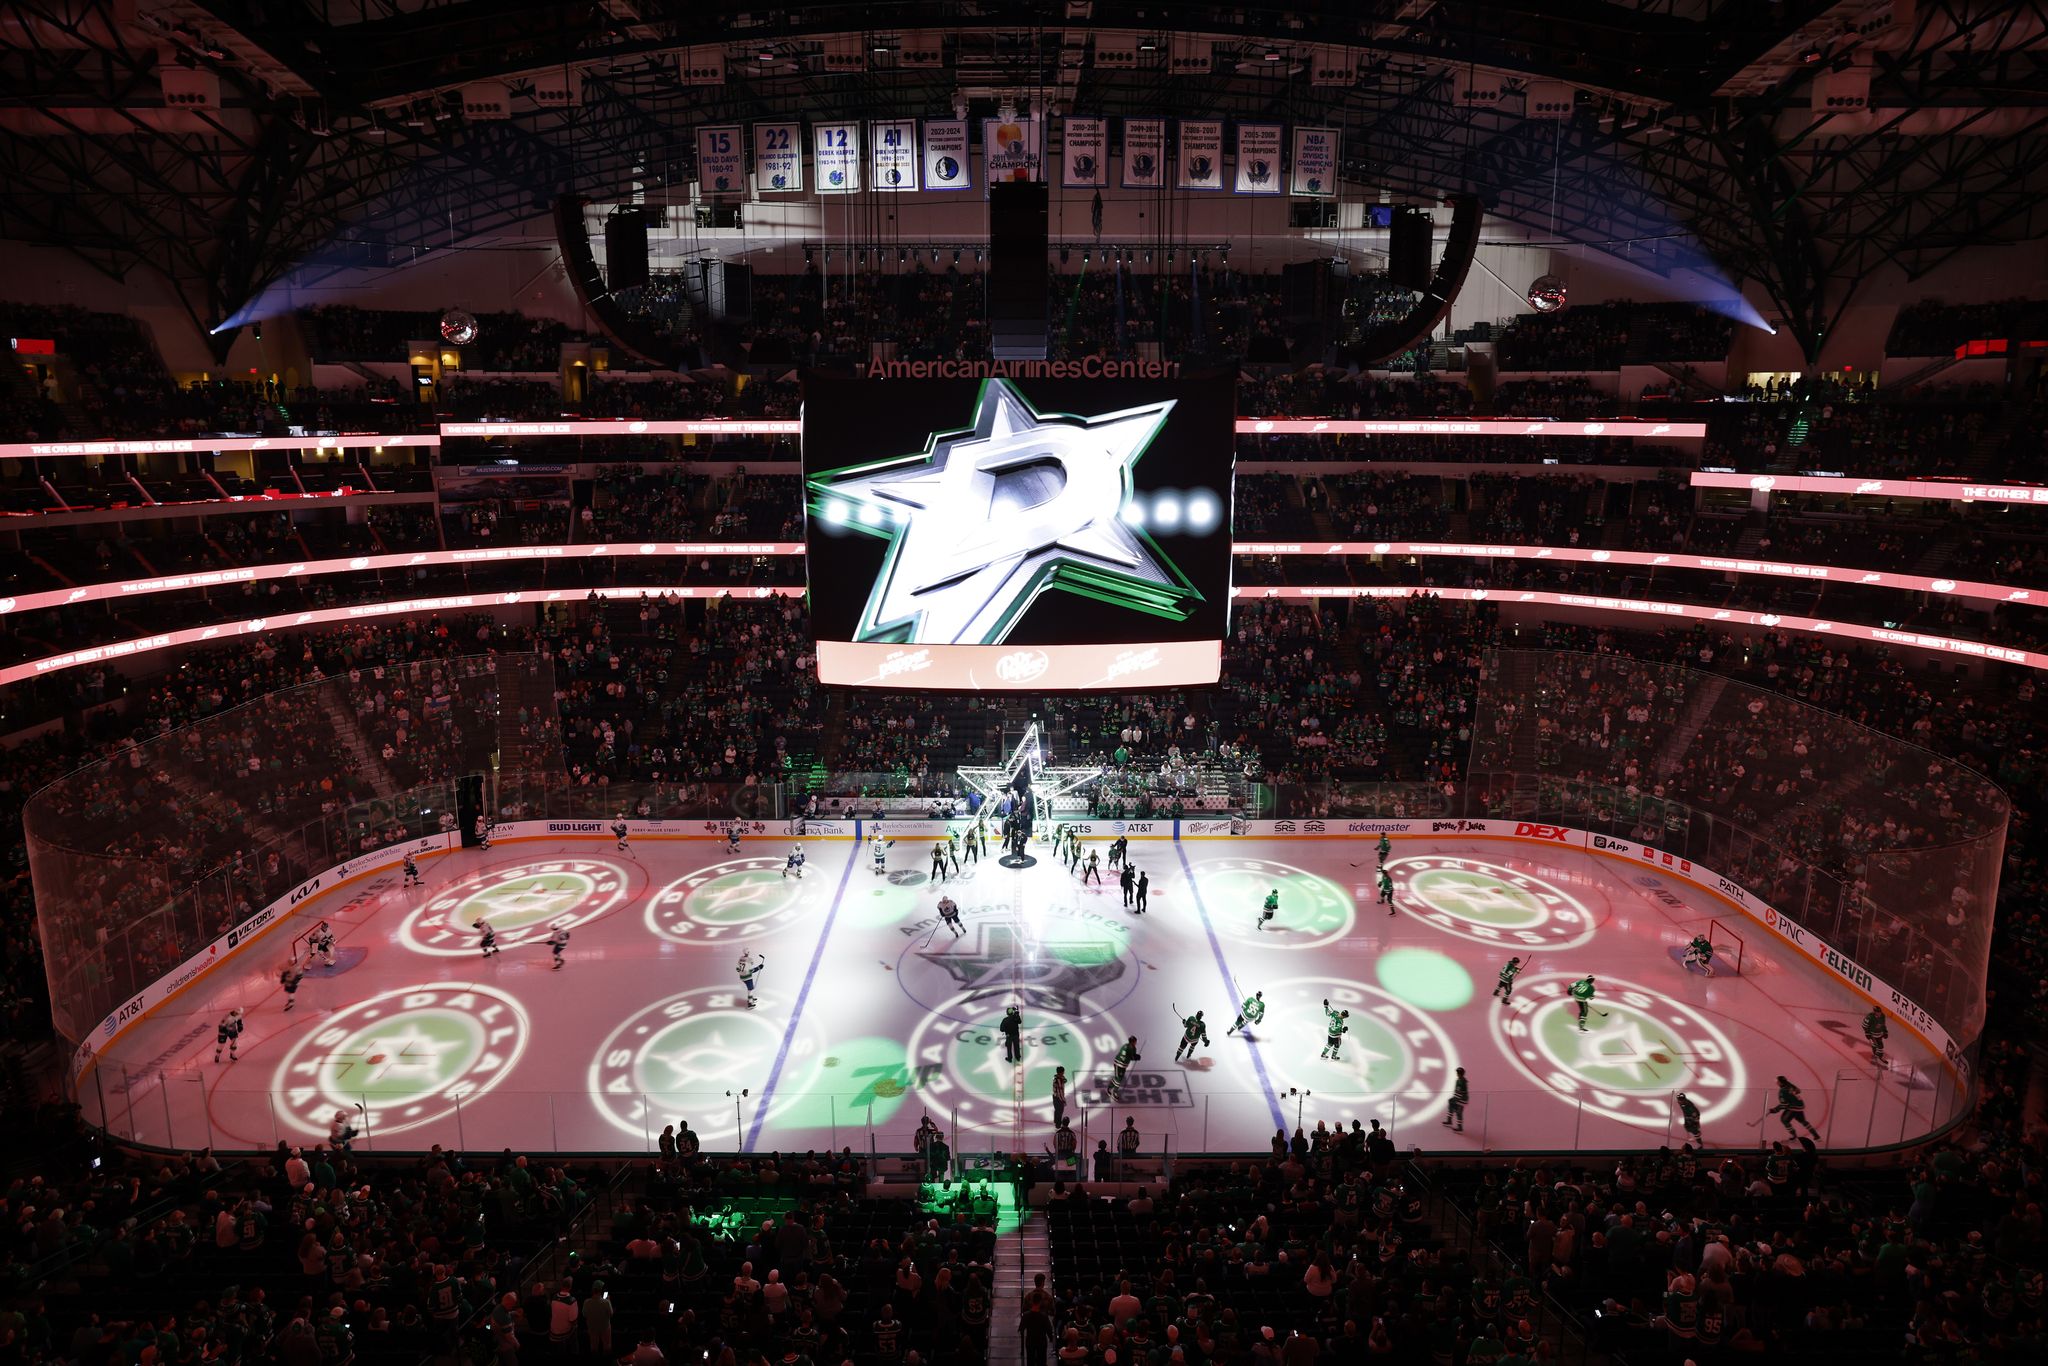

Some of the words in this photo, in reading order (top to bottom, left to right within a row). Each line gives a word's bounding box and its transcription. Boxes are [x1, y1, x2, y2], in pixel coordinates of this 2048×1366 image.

[826, 130, 848, 147] 12
[884, 129, 902, 146] 41
[930, 128, 961, 136] 2023-2024
[709, 133, 730, 154] 15
[766, 129, 789, 150] 22
[1306, 135, 1325, 144] NBA
[930, 144, 962, 152] CHAMPIONS
[720, 155, 738, 164] DAVIS
[992, 154, 1006, 162] 2011
[709, 165, 733, 174] 1980-92
[765, 162, 791, 170] 1981-92
[511, 425, 538, 433] THING
[52, 444, 82, 453] OTHER
[84, 443, 115, 453] BEST
[117, 442, 153, 453] THING
[155, 441, 172, 452] ON
[174, 441, 192, 451] ICE
[1962, 487, 1986, 496] THE
[1988, 489, 2030, 499] OTHER
[1738, 562, 1761, 571] BEST
[1763, 564, 1792, 573] THING
[1793, 567, 1809, 575] ON
[138, 581, 164, 590] OTHER
[165, 577, 190, 587] BEST
[192, 574, 221, 584] THING
[223, 570, 237, 580] ON
[239, 570, 254, 578] ICE
[388, 602, 411, 610] BEST
[413, 600, 440, 608] THING
[442, 598, 456, 606] ON
[1596, 599, 1620, 607] BEST
[1621, 600, 1649, 610] THING
[1651, 603, 1666, 612] ON
[1667, 605, 1683, 613] ICE
[1872, 630, 1888, 638] THE
[1889, 633, 1916, 642] OTHER
[1918, 637, 1947, 647] BEST
[1949, 641, 1985, 654] THING
[1986, 647, 2004, 657] ON
[2006, 651, 2025, 661] ICE
[36, 662, 50, 670] THE
[50, 656, 74, 667] OTHER
[75, 649, 103, 662] BEST
[104, 643, 135, 656] THING
[137, 639, 152, 649] ON
[153, 636, 169, 646] ICE
[824, 826, 844, 834] Bank
[1128, 824, 1153, 832] AT&T
[1349, 823, 1410, 831] ticketmaster
[1433, 822, 1457, 831] Booster
[1466, 821, 1486, 831] Juice
[1514, 823, 1570, 842] DEX
[1406, 861, 1579, 923] DALLAS
[1719, 879, 1744, 900] PATH
[1779, 917, 1805, 945] PNC
[119, 996, 145, 1024] AT&T
[403, 993, 514, 1101] DALLAS
[1332, 988, 1443, 1120] DALLAS
[438, 1290, 453, 1308] 91
[878, 1333, 897, 1354] 53
